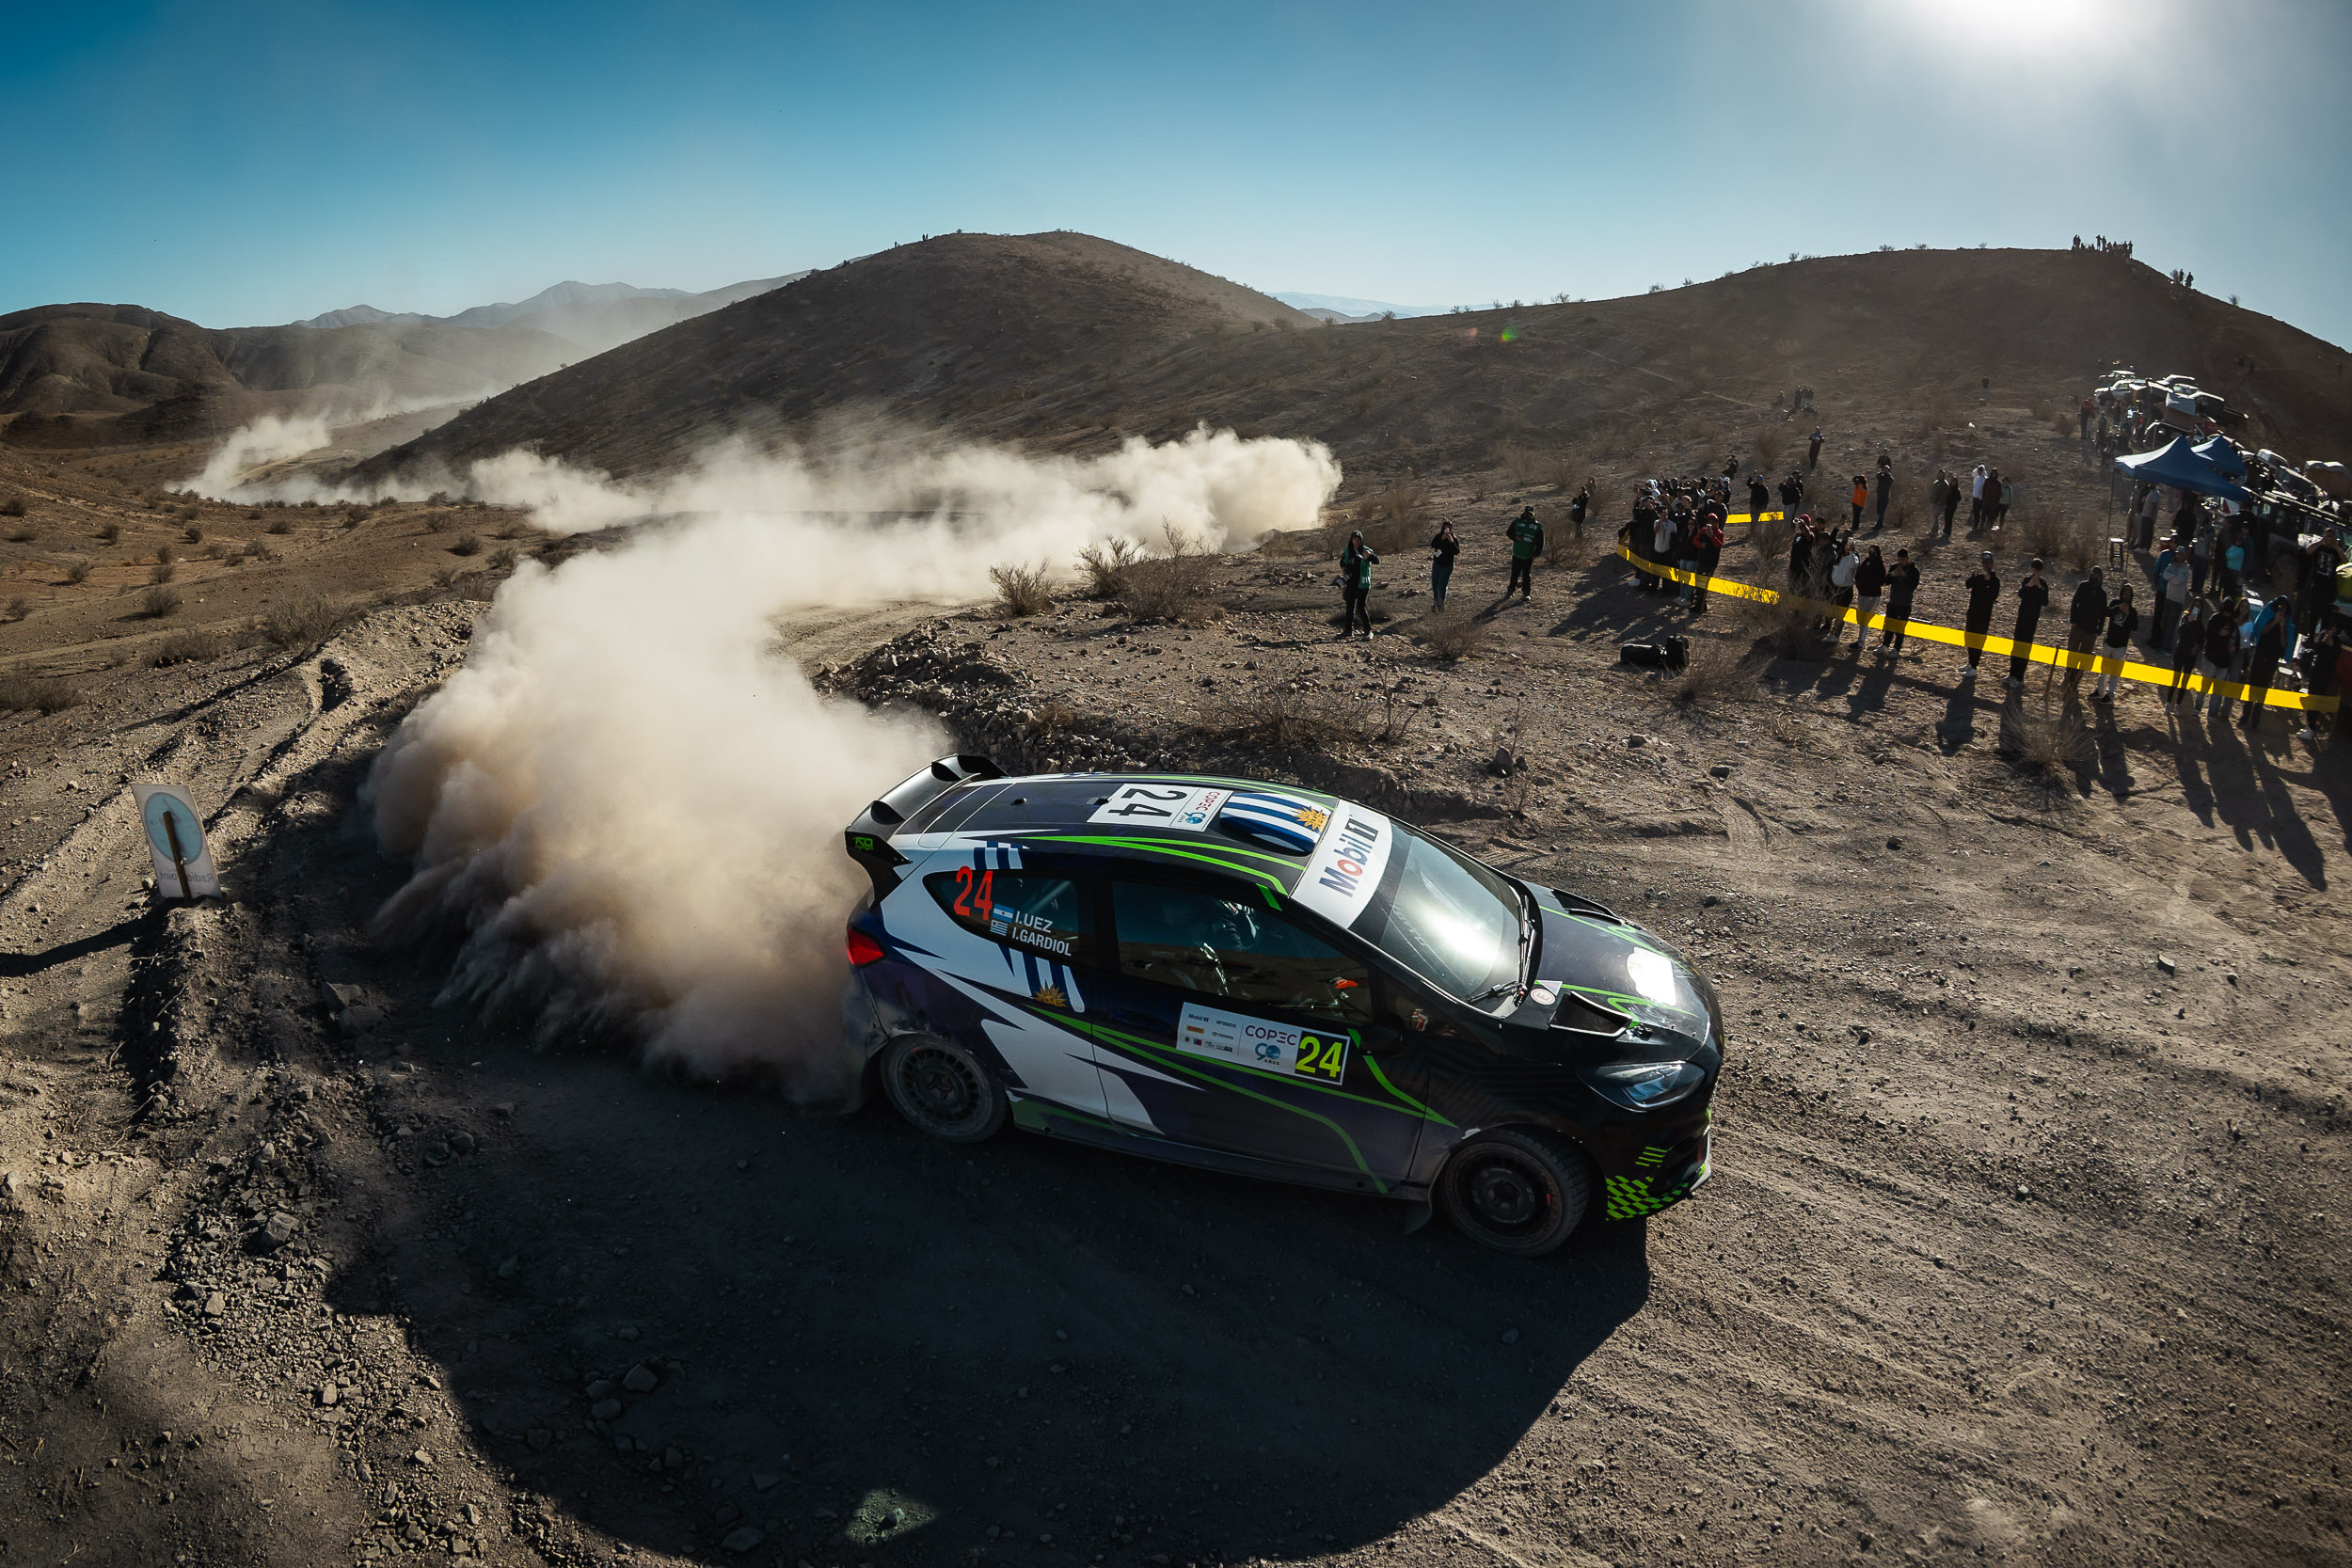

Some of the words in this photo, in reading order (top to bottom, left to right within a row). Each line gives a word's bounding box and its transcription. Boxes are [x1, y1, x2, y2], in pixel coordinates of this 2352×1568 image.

[1107, 788, 1187, 817] 24
[1196, 791, 1220, 811] COPEC
[953, 865, 993, 921] 24
[1015, 911, 1054, 934] I.UEZ
[1011, 927, 1072, 957] I.GARDIOL
[1246, 1025, 1297, 1046] COPEC
[1295, 1037, 1343, 1077] 24
